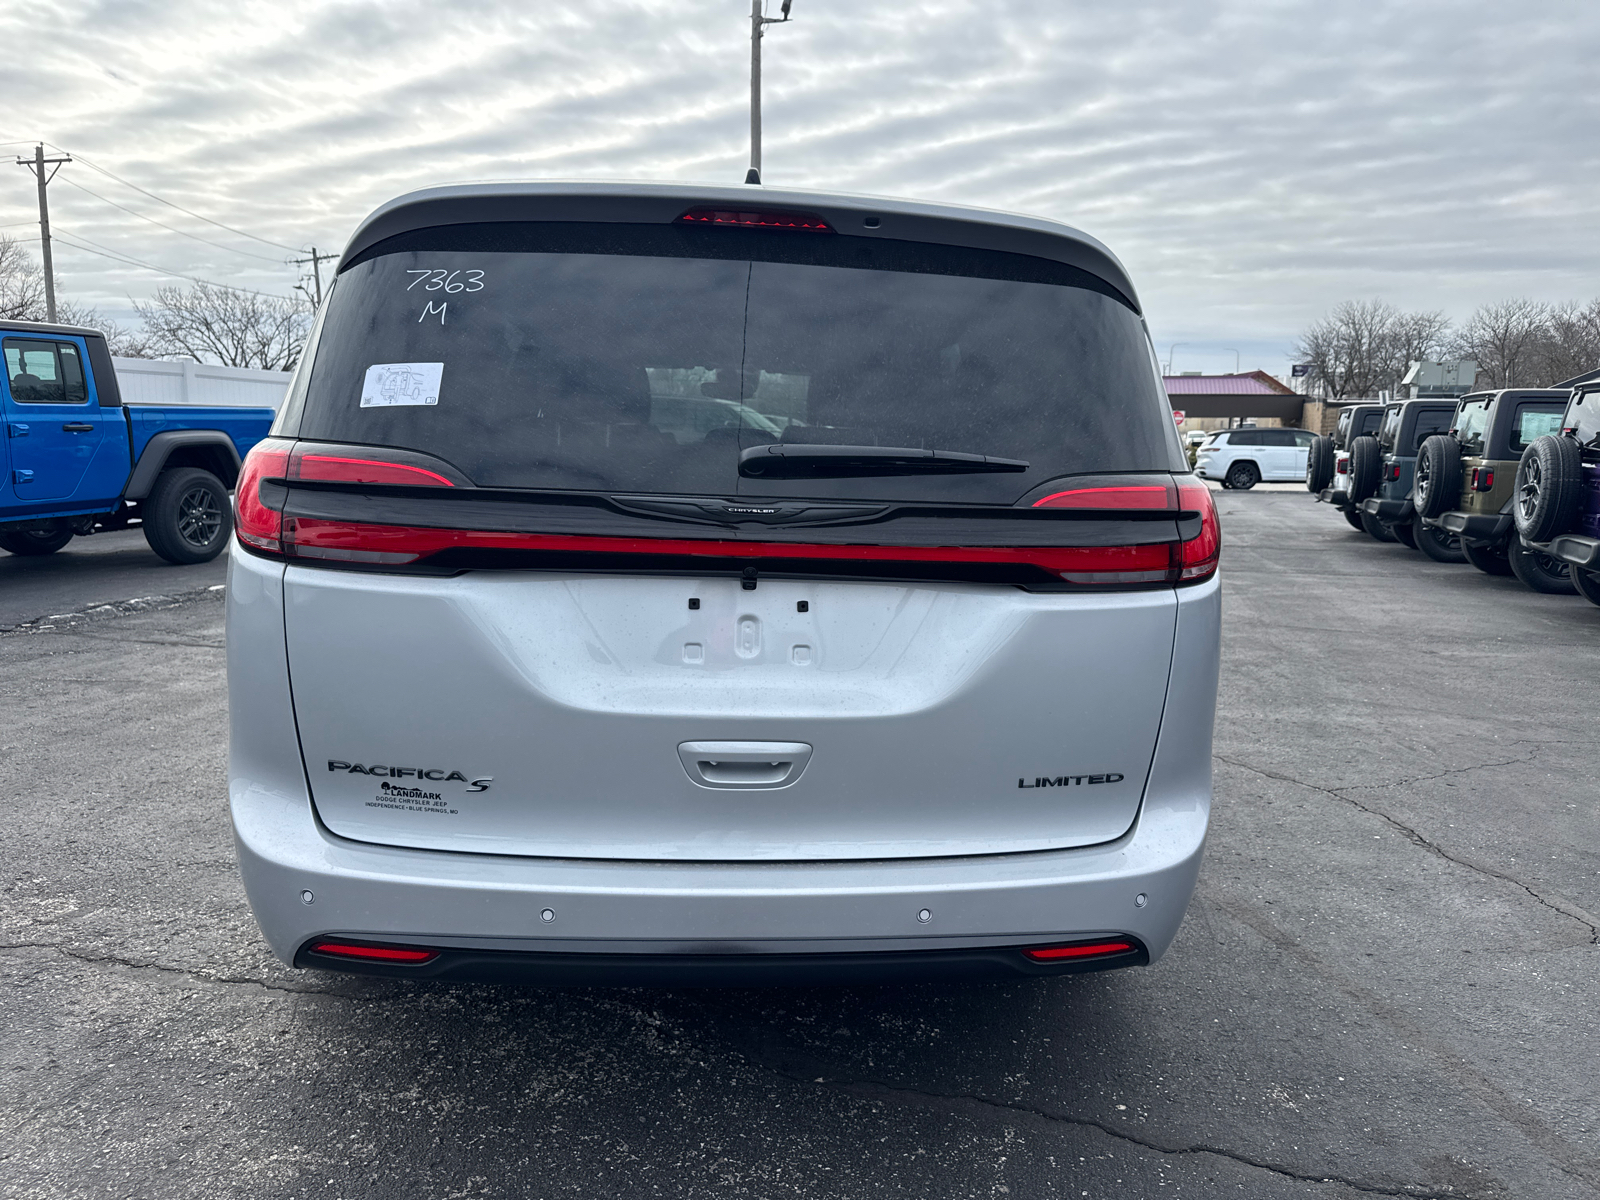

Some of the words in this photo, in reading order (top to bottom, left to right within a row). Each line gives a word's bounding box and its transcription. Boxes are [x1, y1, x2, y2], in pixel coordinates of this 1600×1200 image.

[406, 269, 485, 294] 7363
[418, 300, 447, 325] M
[327, 759, 468, 783] PACIFICA
[466, 776, 494, 793] S
[1018, 772, 1125, 788] LIMITED
[390, 789, 442, 800] LANDMARK
[398, 798, 431, 806] CHRYSLER
[365, 802, 405, 810] INDEPENDENCE
